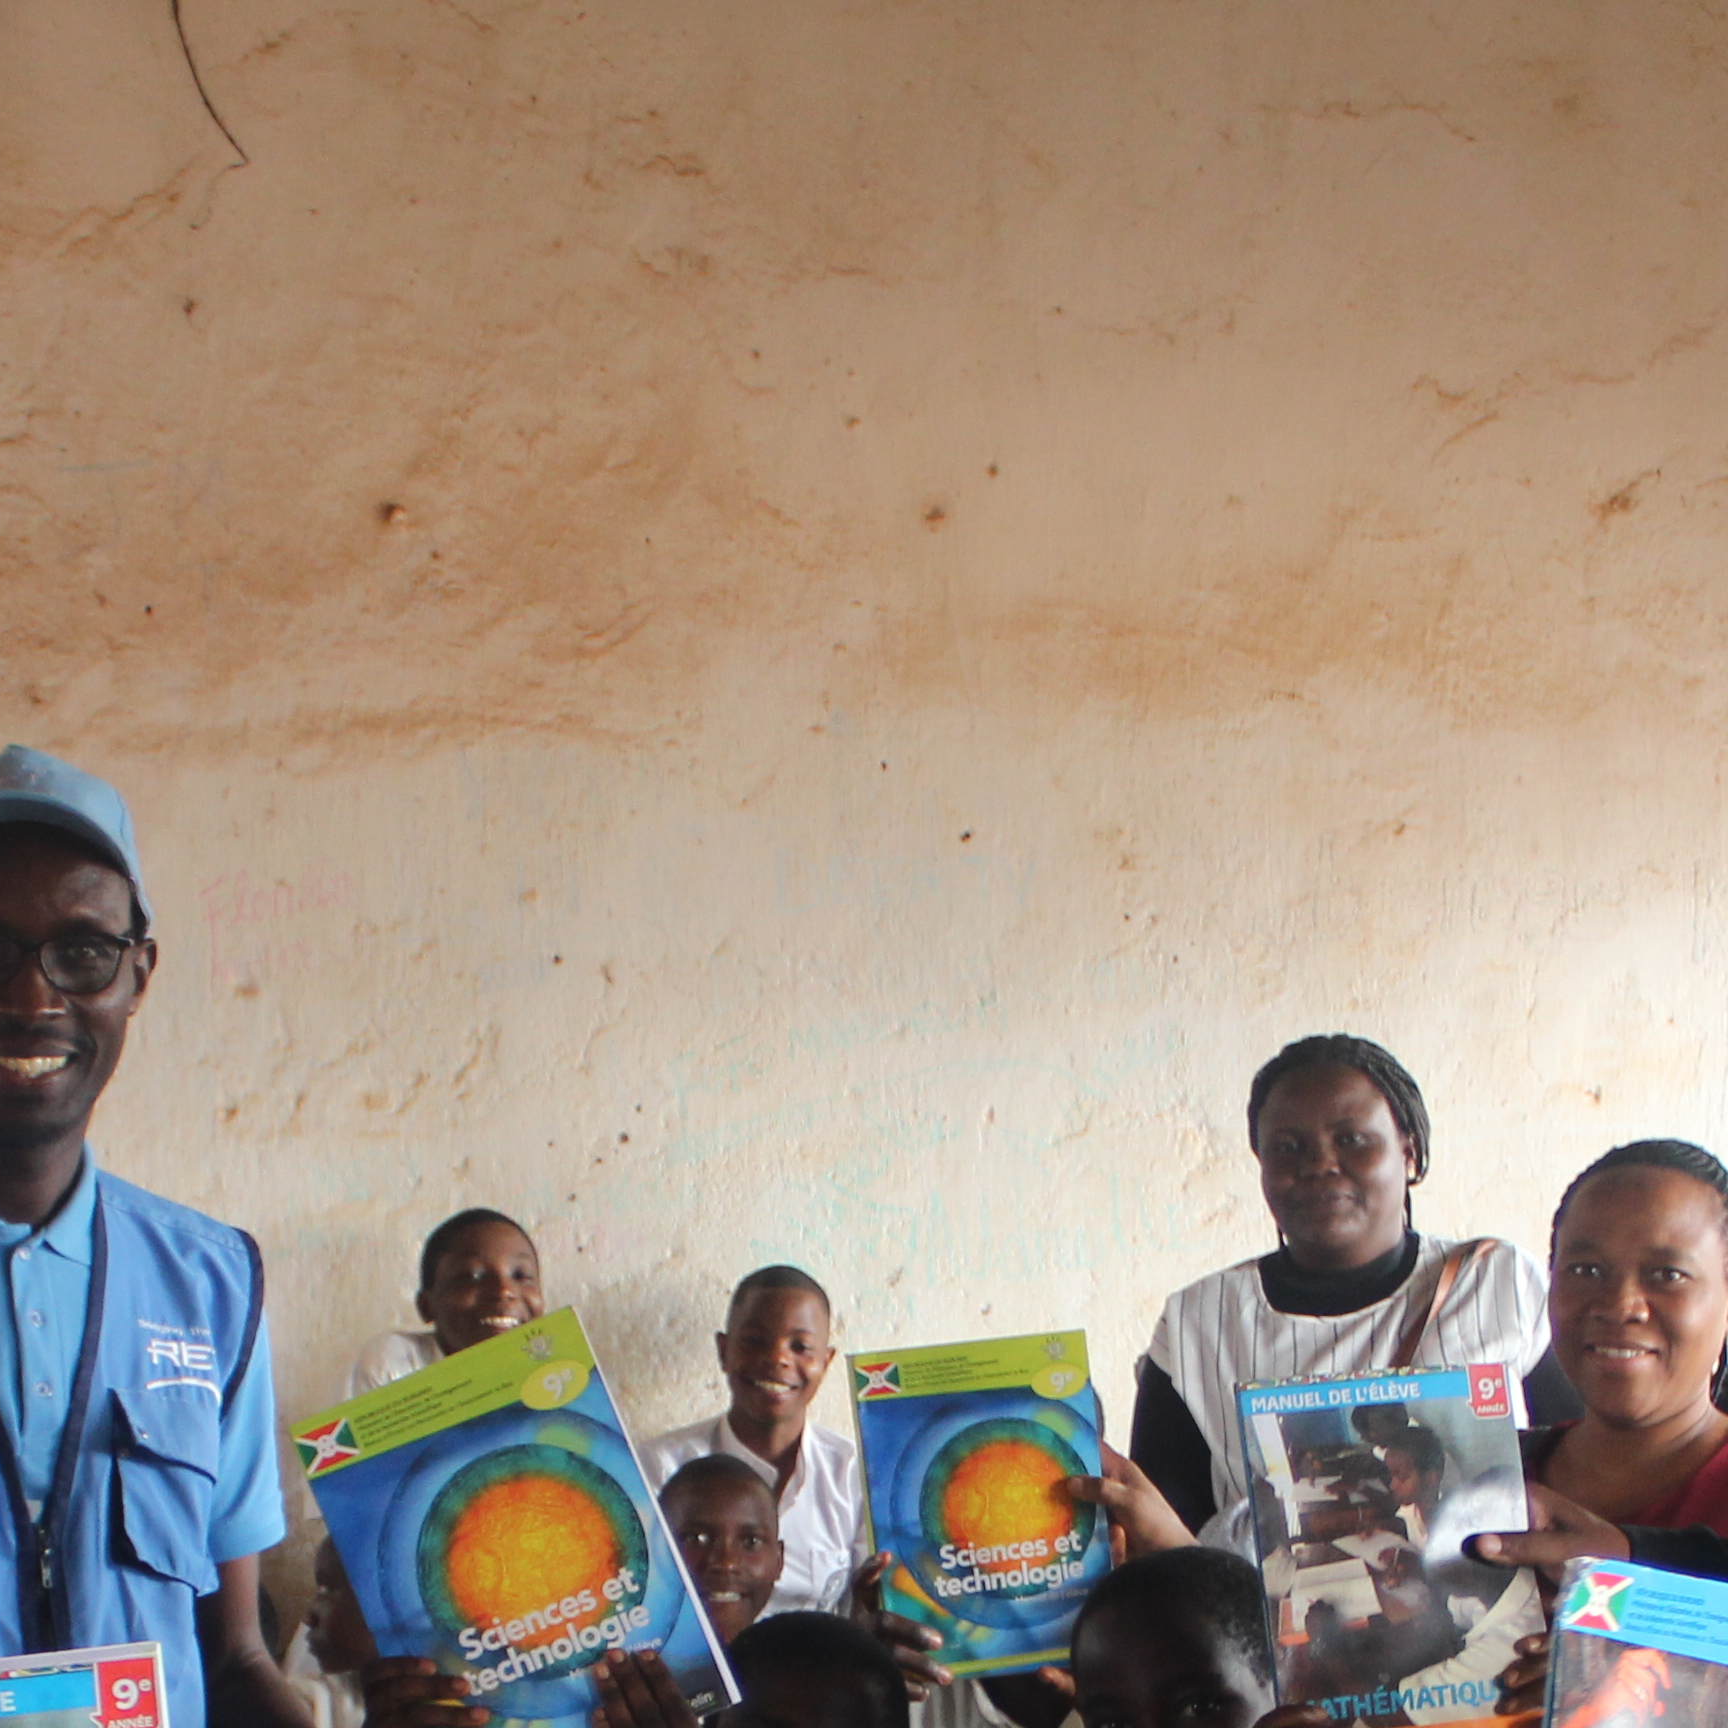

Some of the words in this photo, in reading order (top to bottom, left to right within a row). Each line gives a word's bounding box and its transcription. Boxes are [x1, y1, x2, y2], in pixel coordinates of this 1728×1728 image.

[542, 1368, 574, 1401] 9e
[1251, 1393, 1326, 1413] MANUEL
[1328, 1388, 1352, 1405] DE
[1355, 1381, 1420, 1402] L'ÉLÈVE
[1478, 1377, 1503, 1400] 9e
[939, 1538, 1048, 1570] Sciences
[1054, 1529, 1082, 1554] et
[934, 1556, 1085, 1598] technologie
[458, 1587, 598, 1661] Sciences
[602, 1566, 640, 1600] et
[461, 1603, 651, 1697] technologie
[112, 1678, 153, 1711] 9e
[688, 1691, 714, 1708] elin
[1308, 1677, 1502, 1720] ATHÉMATIQU
